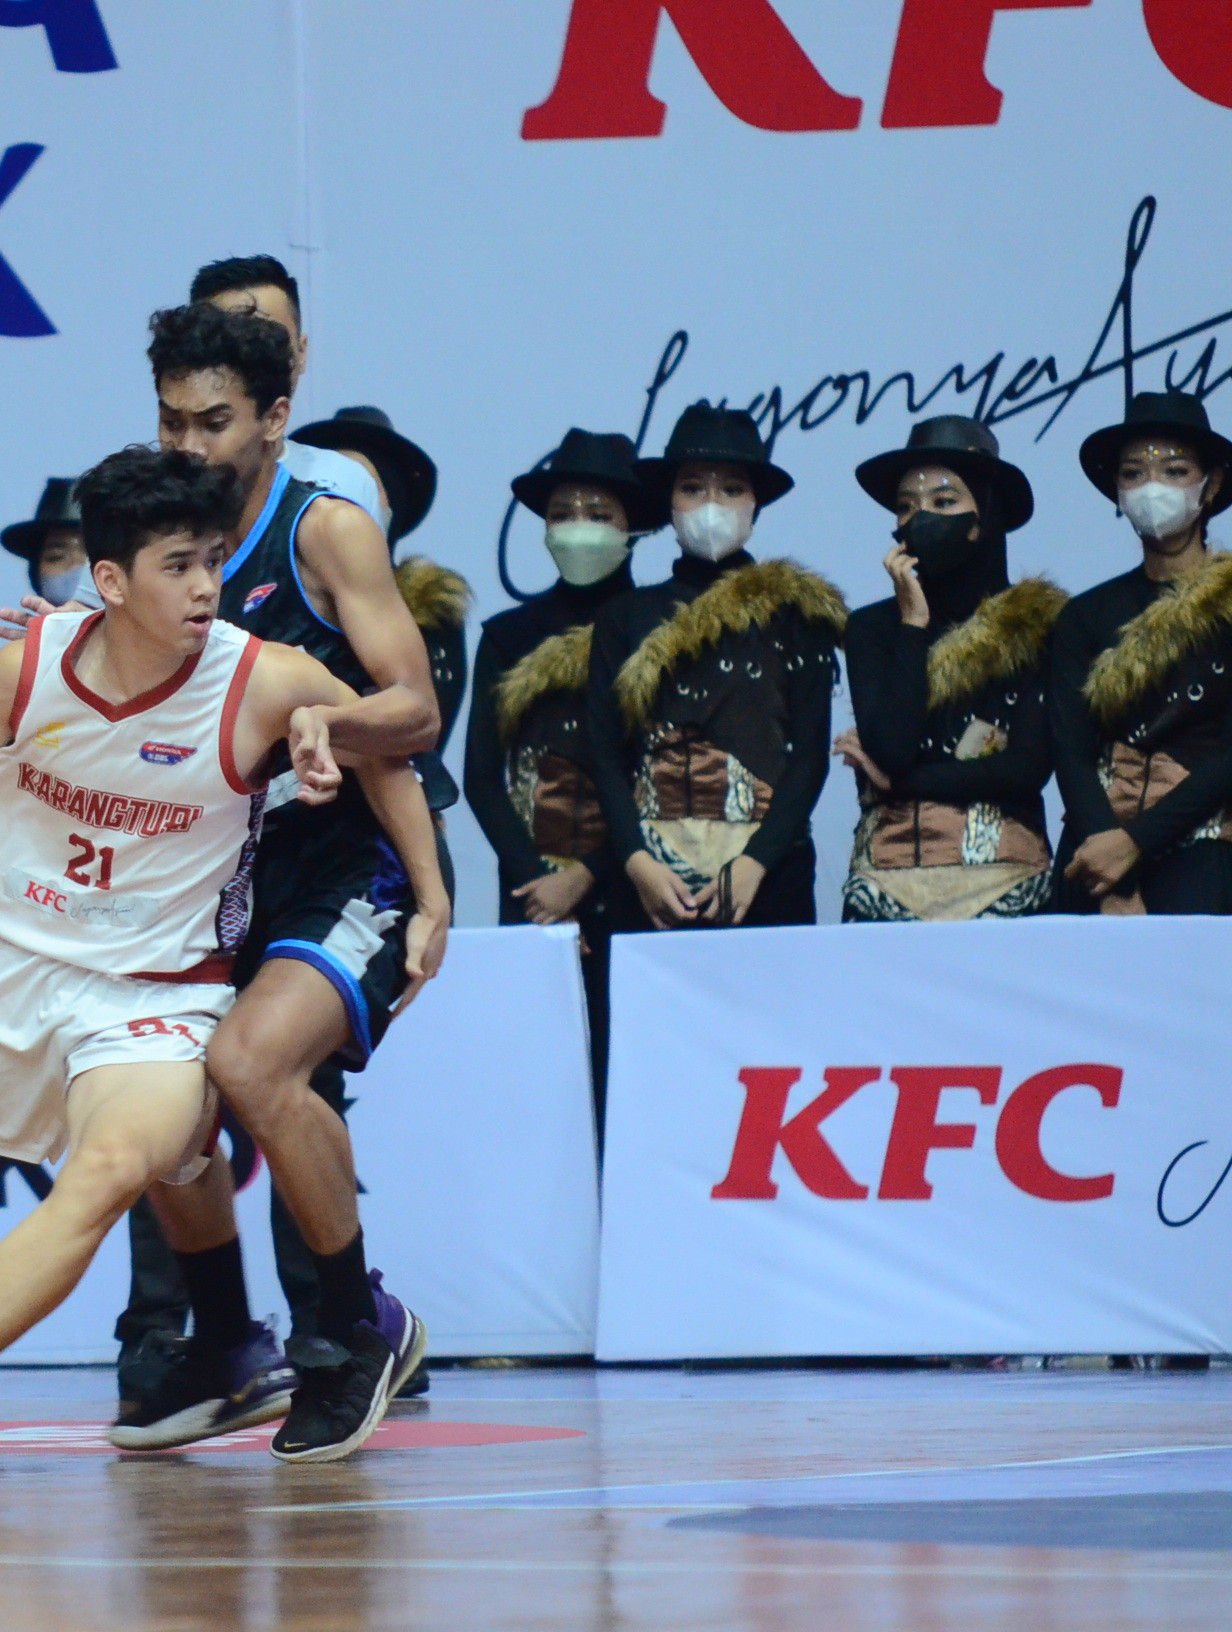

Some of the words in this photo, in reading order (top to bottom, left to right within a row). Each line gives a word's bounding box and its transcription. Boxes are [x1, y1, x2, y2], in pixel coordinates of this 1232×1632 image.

[520, 0, 1232, 141] KF
[24, 880, 68, 913] KFC
[63, 832, 115, 890] 21
[710, 1062, 1125, 1203] KFC
